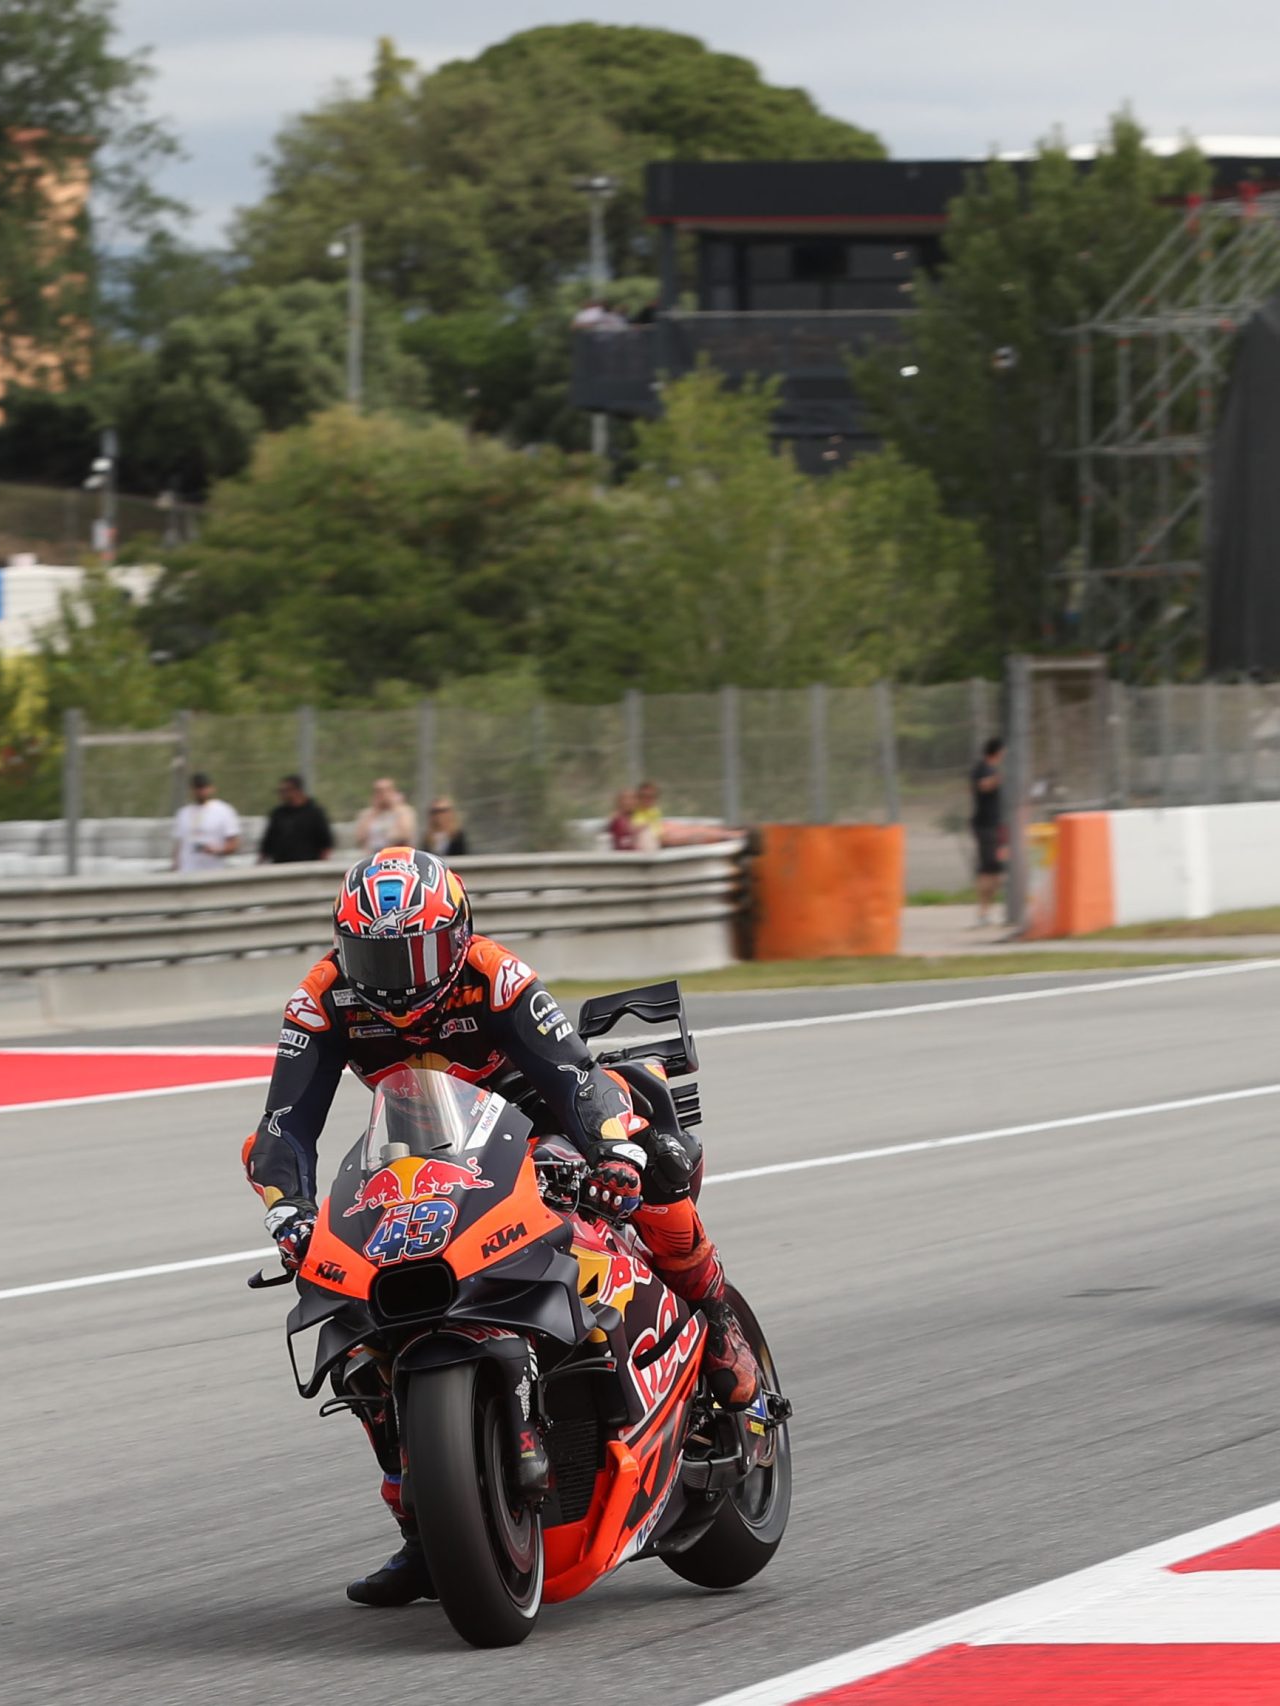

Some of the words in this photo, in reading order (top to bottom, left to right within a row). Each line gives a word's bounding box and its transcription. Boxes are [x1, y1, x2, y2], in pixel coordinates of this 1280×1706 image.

[363, 1198, 458, 1265] 43
[480, 1222, 528, 1259] KTM
[315, 1260, 348, 1285] KTM
